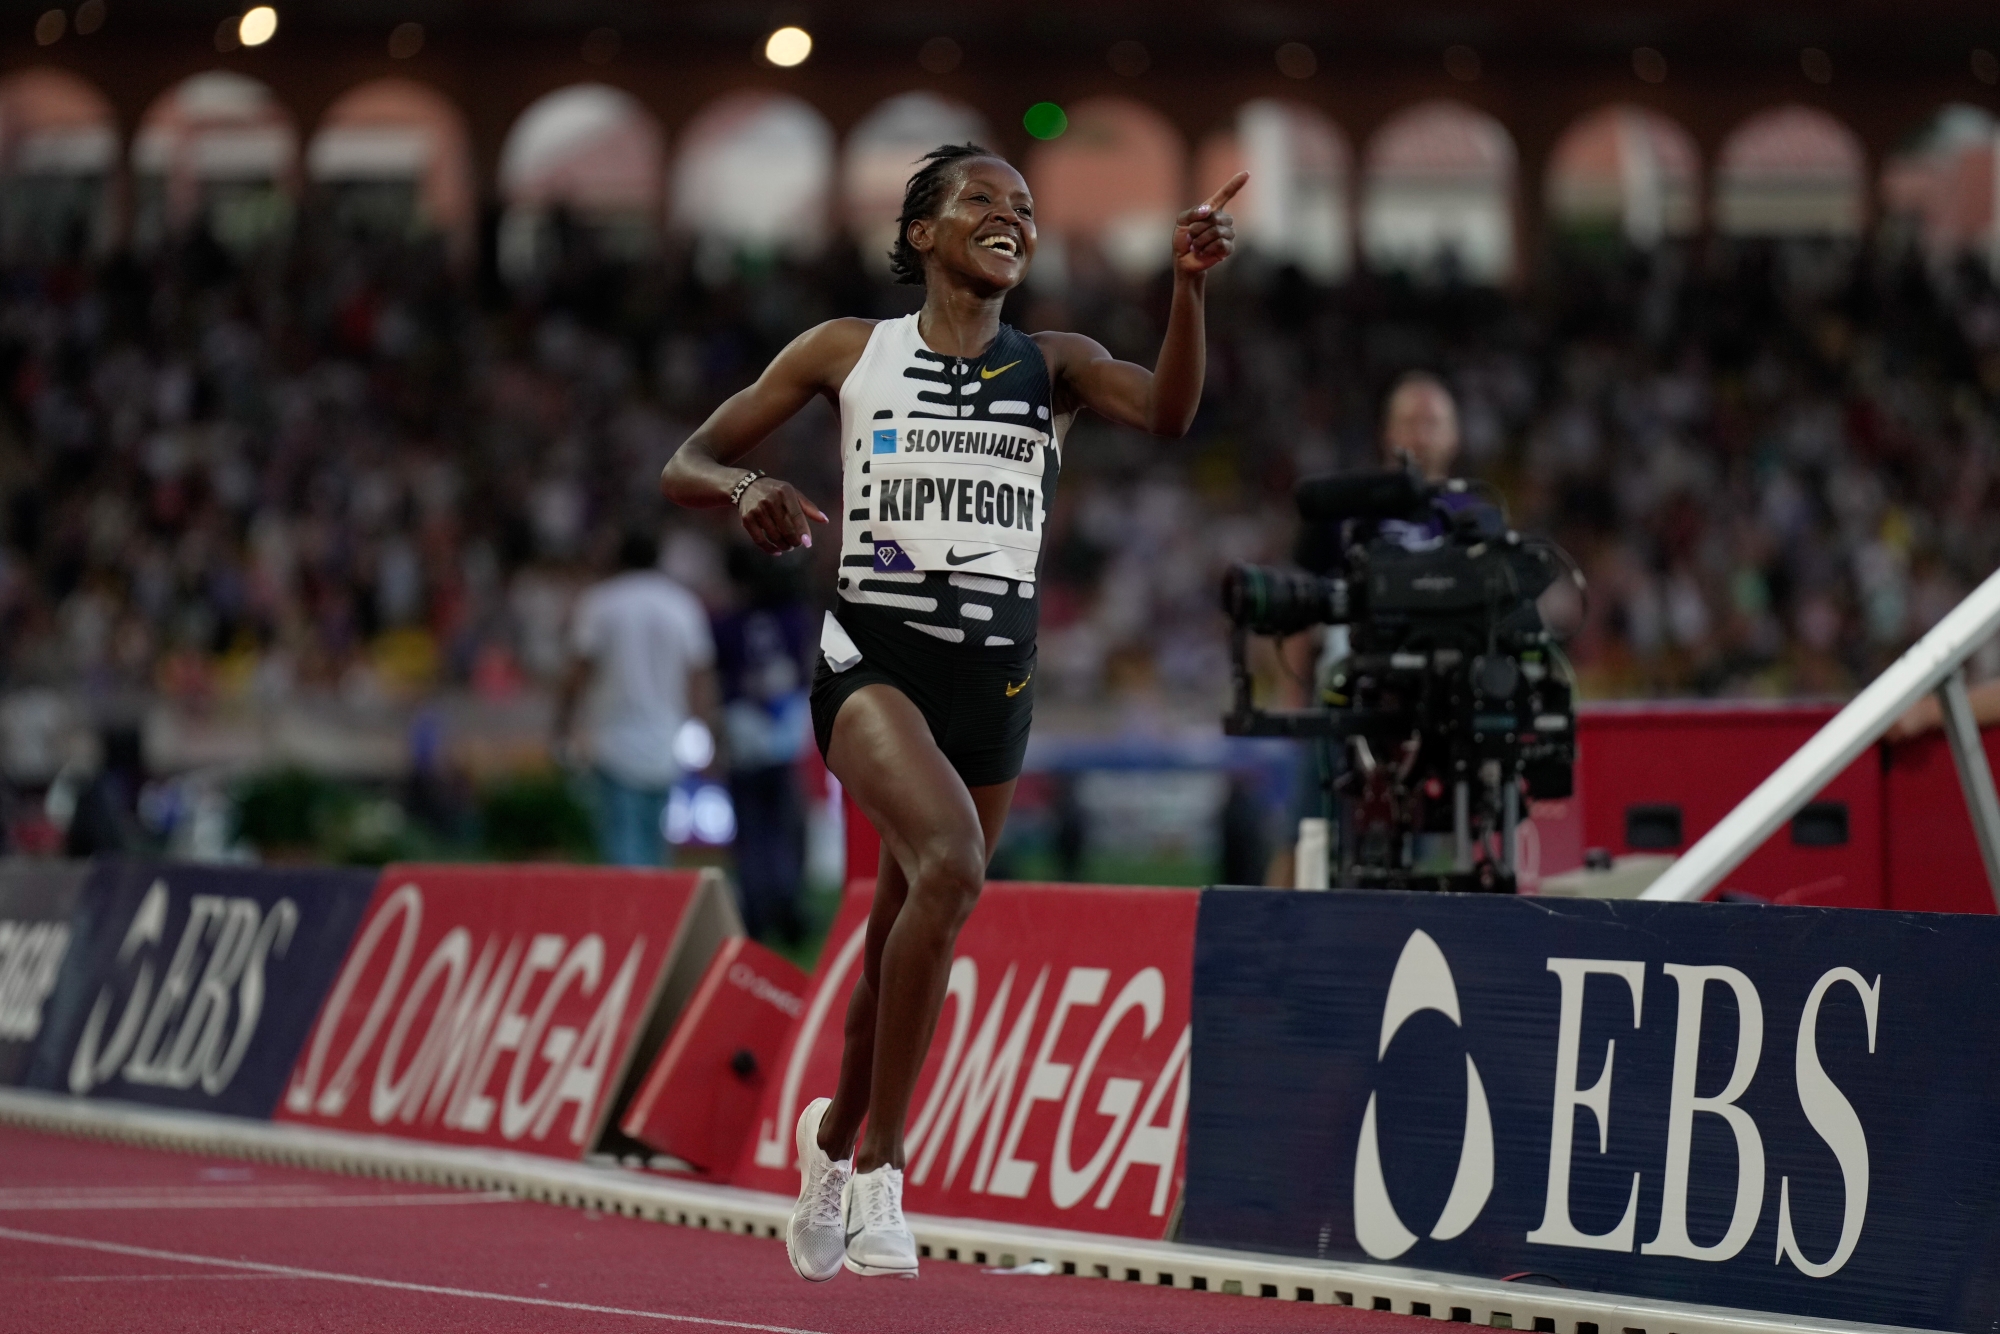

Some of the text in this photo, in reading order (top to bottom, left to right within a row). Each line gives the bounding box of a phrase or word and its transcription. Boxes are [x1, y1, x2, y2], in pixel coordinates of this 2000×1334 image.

[879, 478, 1035, 532] KIPYEGON
[904, 429, 1036, 463] SLOVENIJALES
[122, 894, 299, 1096] EBS
[369, 925, 648, 1144] OMEGA
[1526, 956, 1881, 1278] EBS
